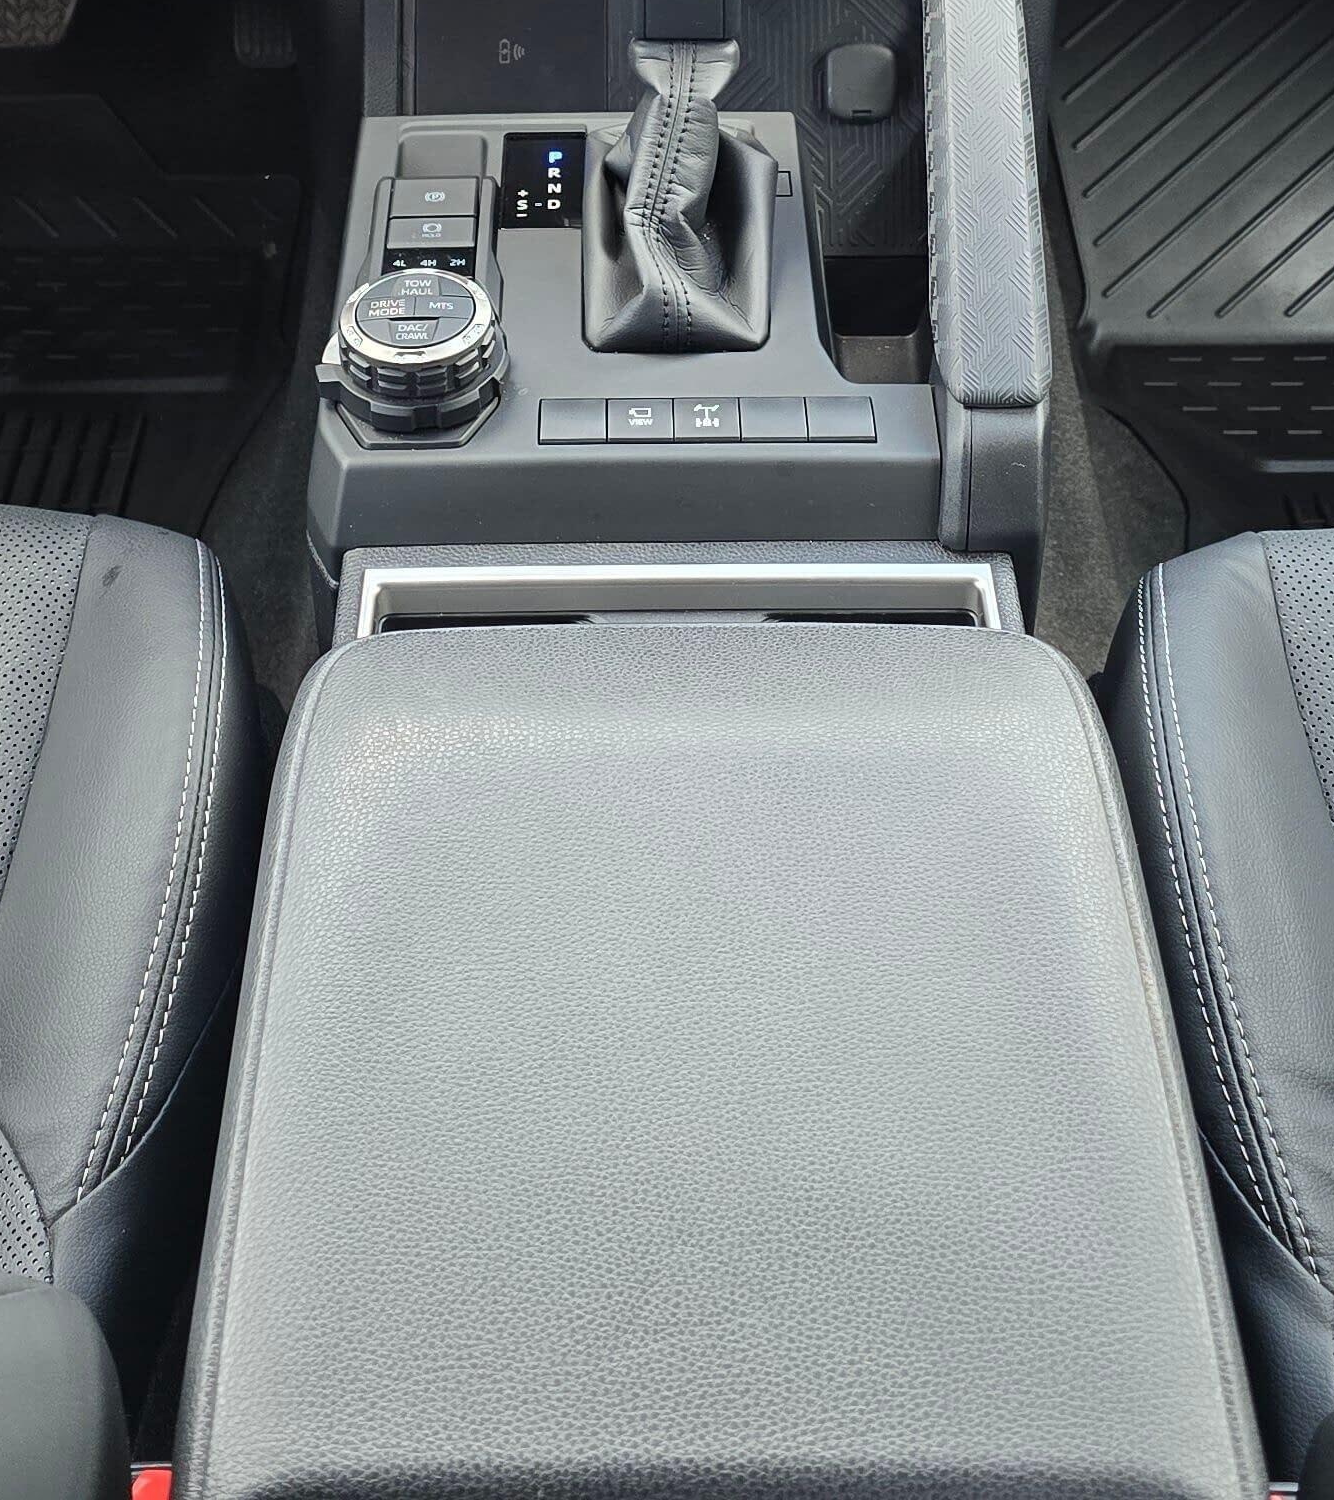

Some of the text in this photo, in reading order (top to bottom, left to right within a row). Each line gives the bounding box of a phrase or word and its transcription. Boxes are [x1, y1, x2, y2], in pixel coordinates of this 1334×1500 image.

[549, 151, 562, 163] P
[548, 167, 561, 178] R
[548, 183, 561, 193] N
[516, 199, 561, 210] S D
[420, 259, 437, 267] 4H
[450, 258, 466, 266] 2H
[401, 288, 433, 296] HAUL
[370, 299, 406, 309] DRIVE
[429, 302, 453, 310] MTS
[368, 308, 406, 317] MODE
[398, 323, 428, 332] DAC/
[395, 332, 429, 340] CRAWL
[628, 418, 653, 426] VIEW
